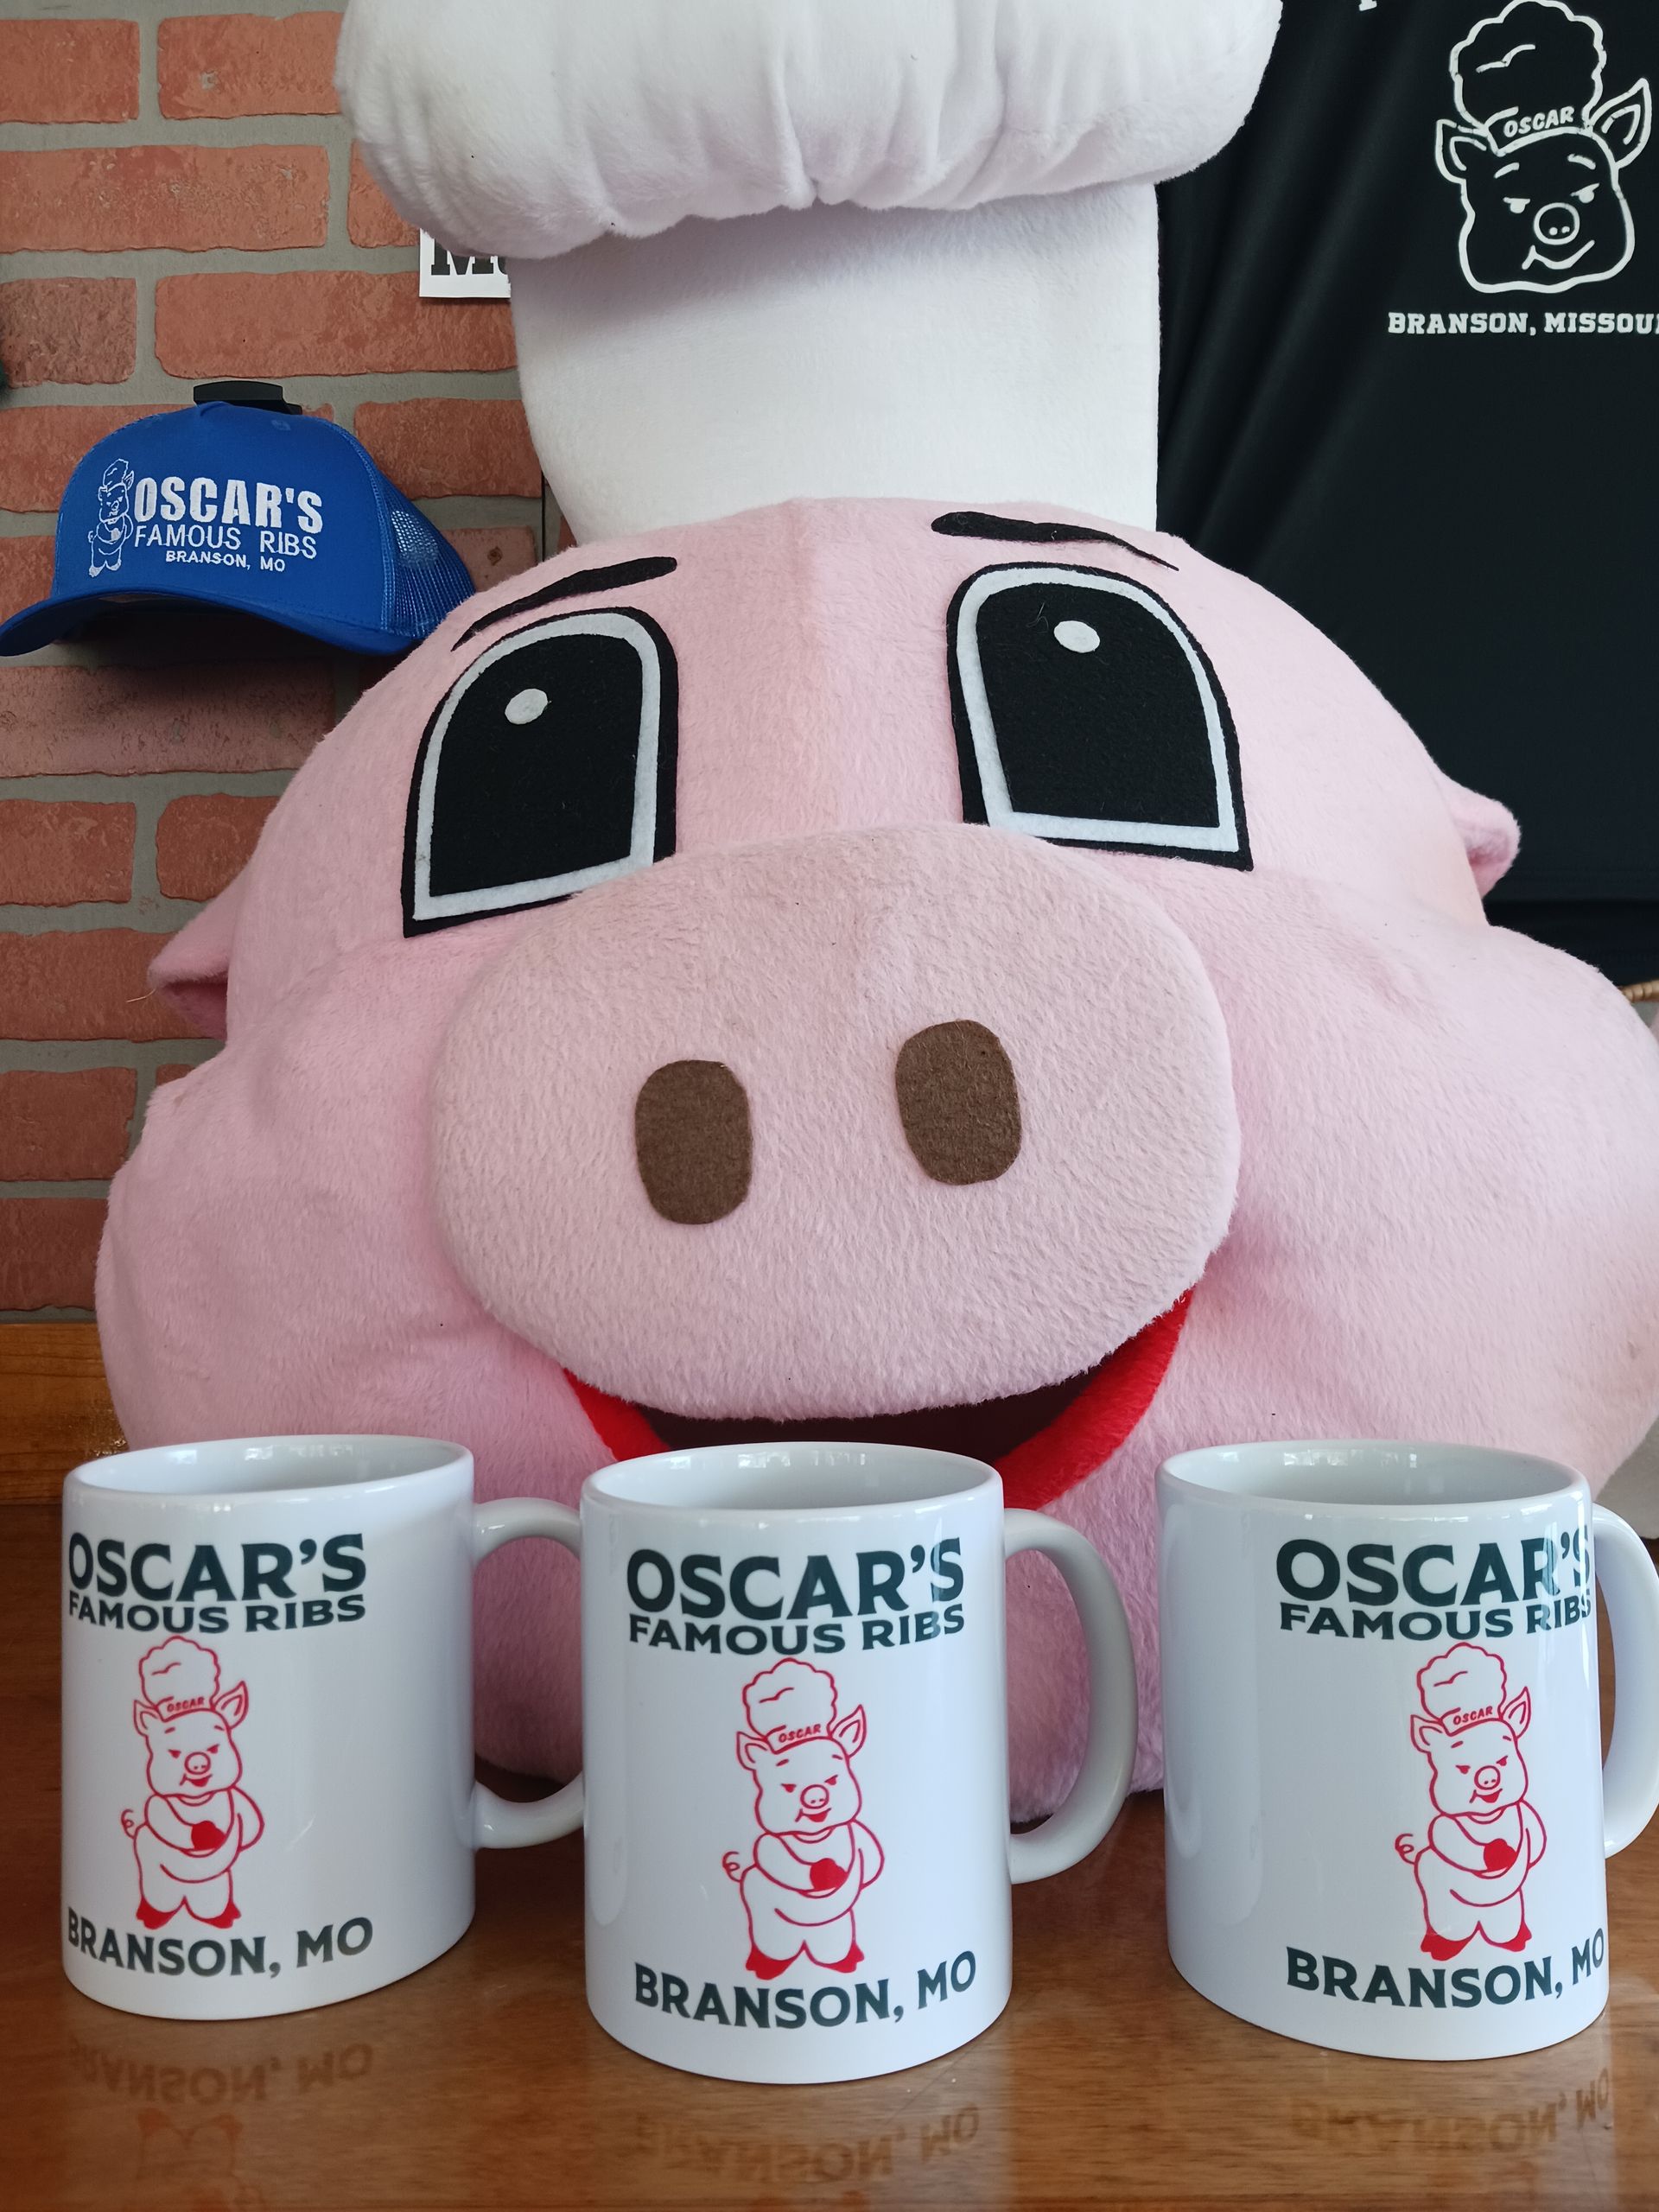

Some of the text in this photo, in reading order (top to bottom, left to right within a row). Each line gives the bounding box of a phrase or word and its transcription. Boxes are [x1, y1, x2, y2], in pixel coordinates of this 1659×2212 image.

[1503, 105, 1575, 138] OSCAR
[1388, 311, 1659, 336] BRANSON, MISSOU
[134, 476, 324, 534] OSCAR'S
[134, 524, 317, 559] FAMOUS RIBS
[165, 550, 286, 572] BRANSON, MO
[68, 1532, 367, 1603] OSCAR'S
[626, 1537, 965, 1622] OSCAR'S
[1275, 1524, 1591, 1608] OSCAR'S
[69, 1590, 365, 1635] FAMOUS RIBS
[628, 1603, 966, 1656] FAMOUS RIBS
[1279, 1588, 1592, 1642] FAMOUS RIBS
[167, 1696, 205, 1713] OSCAR
[1452, 1706, 1493, 1726] OSCAR
[779, 1723, 821, 1743] OSCAR
[68, 1905, 373, 1979] BRANSON, MO
[1285, 1927, 1605, 2009] BRANSON, MO
[634, 1950, 977, 2030] BRANSON, MO
